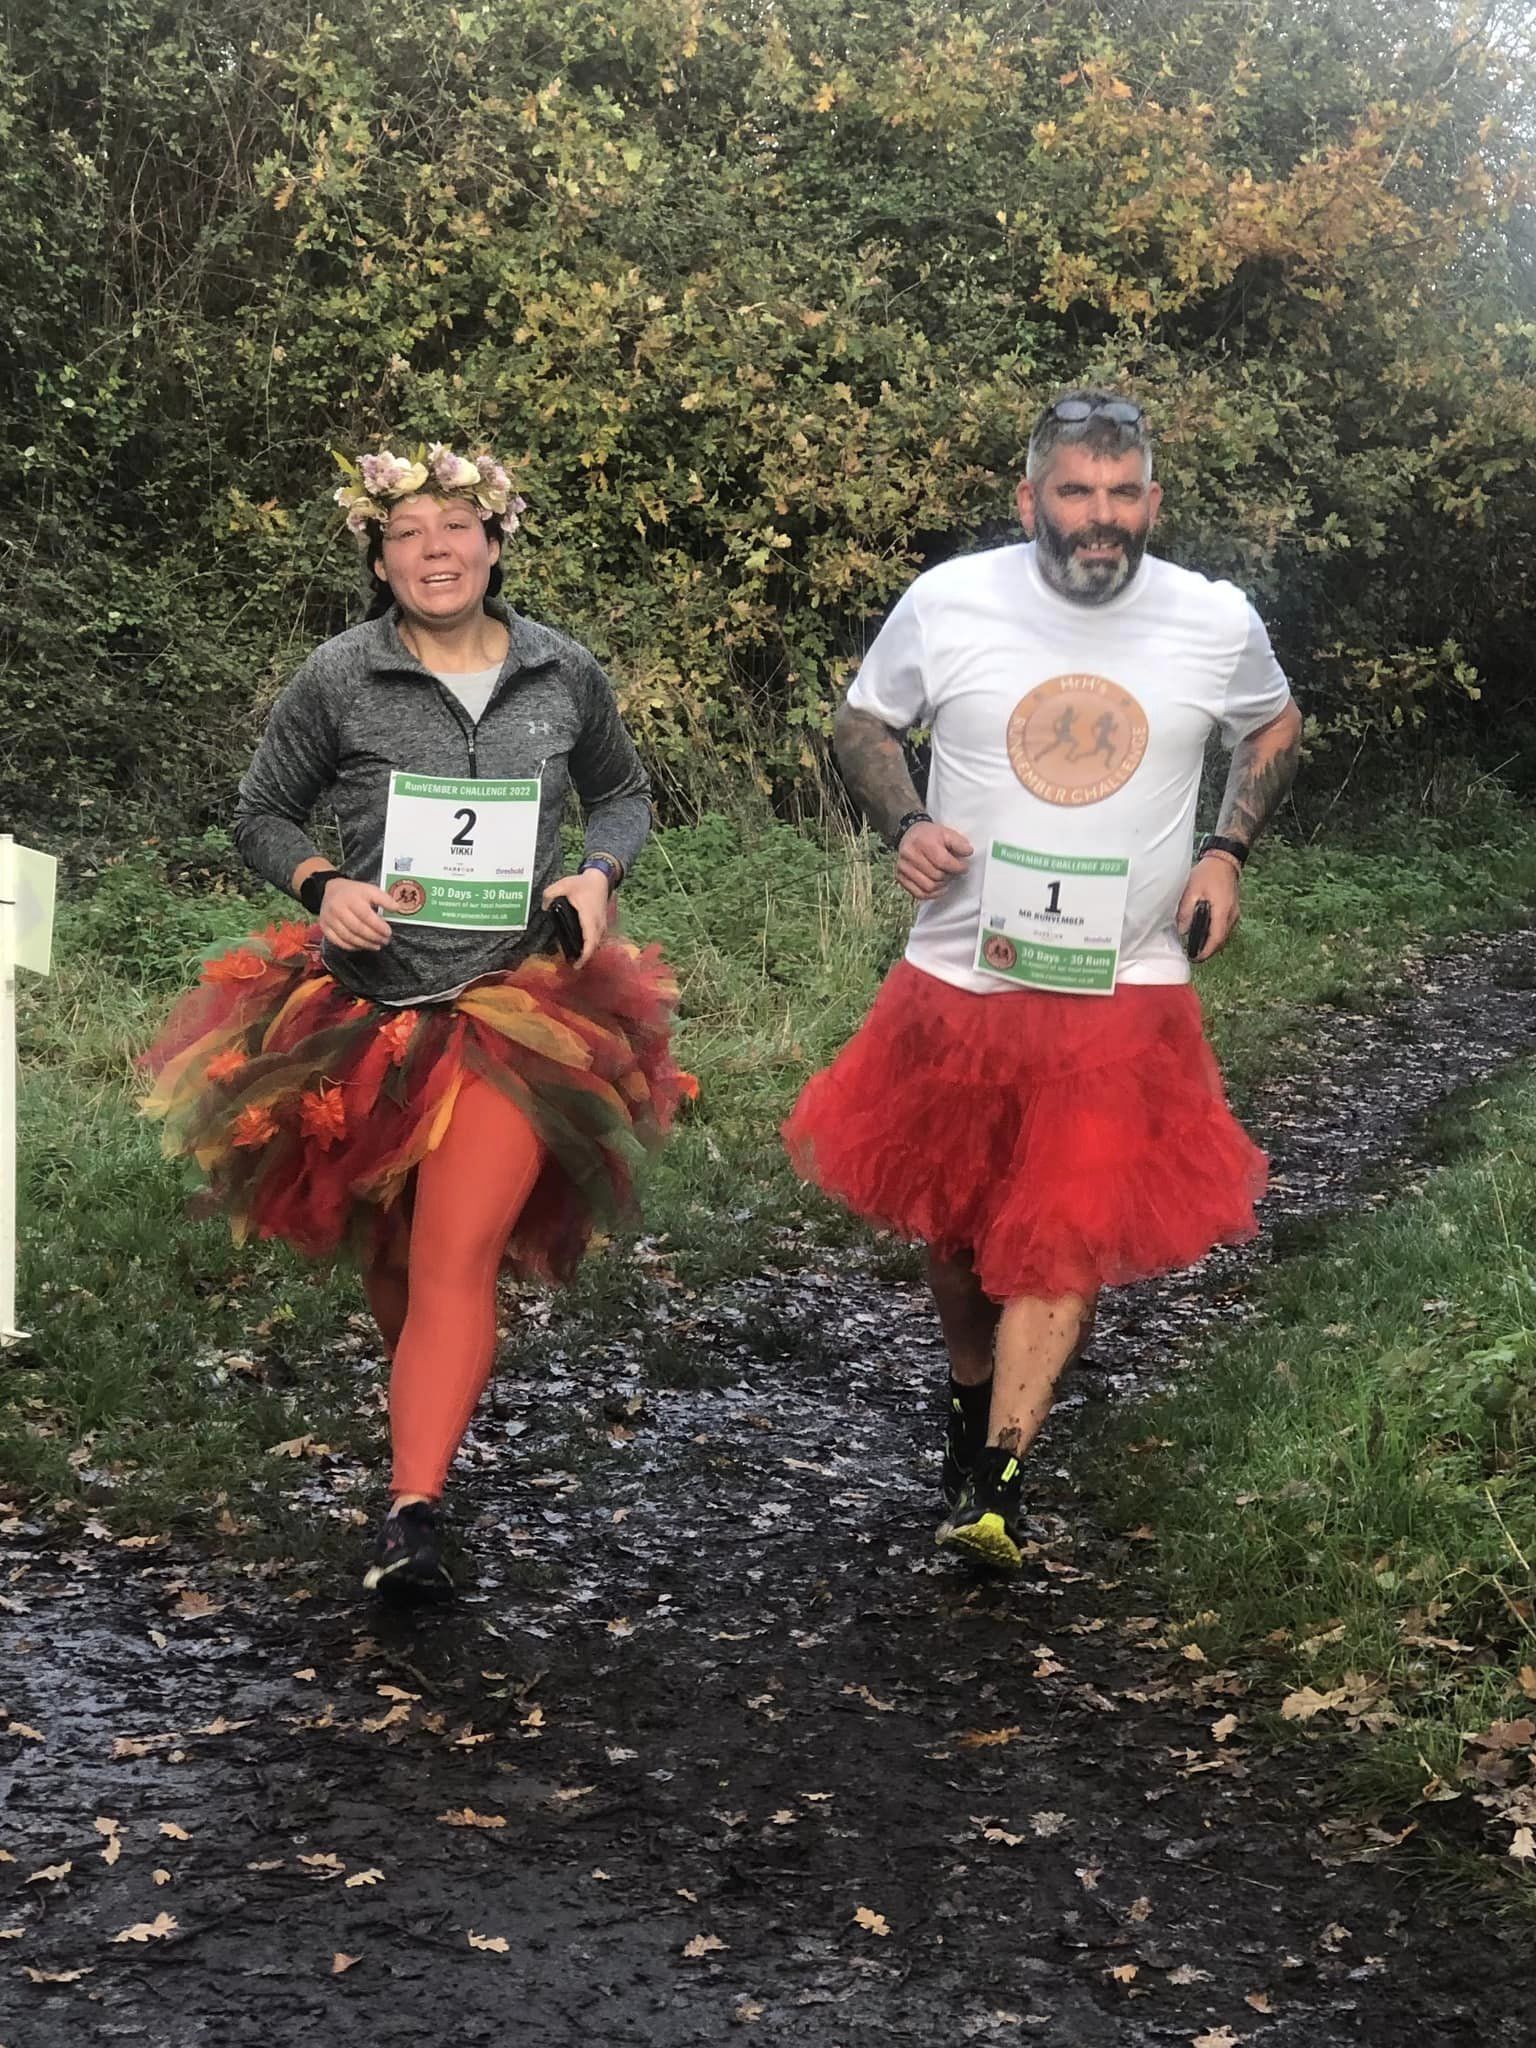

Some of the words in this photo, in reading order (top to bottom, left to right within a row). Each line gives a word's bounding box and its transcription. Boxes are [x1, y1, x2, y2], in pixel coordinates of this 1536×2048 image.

[405, 781, 458, 795] RunVEMBER
[460, 786, 507, 796] CHALLENGE
[509, 786, 531, 796] 2022
[452, 808, 477, 846] 2
[450, 847, 473, 856] VIKKI
[1000, 848, 1049, 866] RunVEMBER
[1051, 860, 1097, 872] CHALLENGE
[1100, 863, 1121, 872] 2022
[431, 886, 444, 897] 30
[447, 887, 472, 900] Days
[483, 889, 495, 899] 30
[498, 889, 524, 900] Runs
[1044, 880, 1061, 914] 1
[1018, 909, 1032, 919] MR
[1034, 911, 1085, 926] RUNVEMBER
[1021, 948, 1033, 959] 30
[1037, 951, 1060, 964] Days
[1071, 956, 1083, 965] 30
[1086, 957, 1110, 966] Runs
